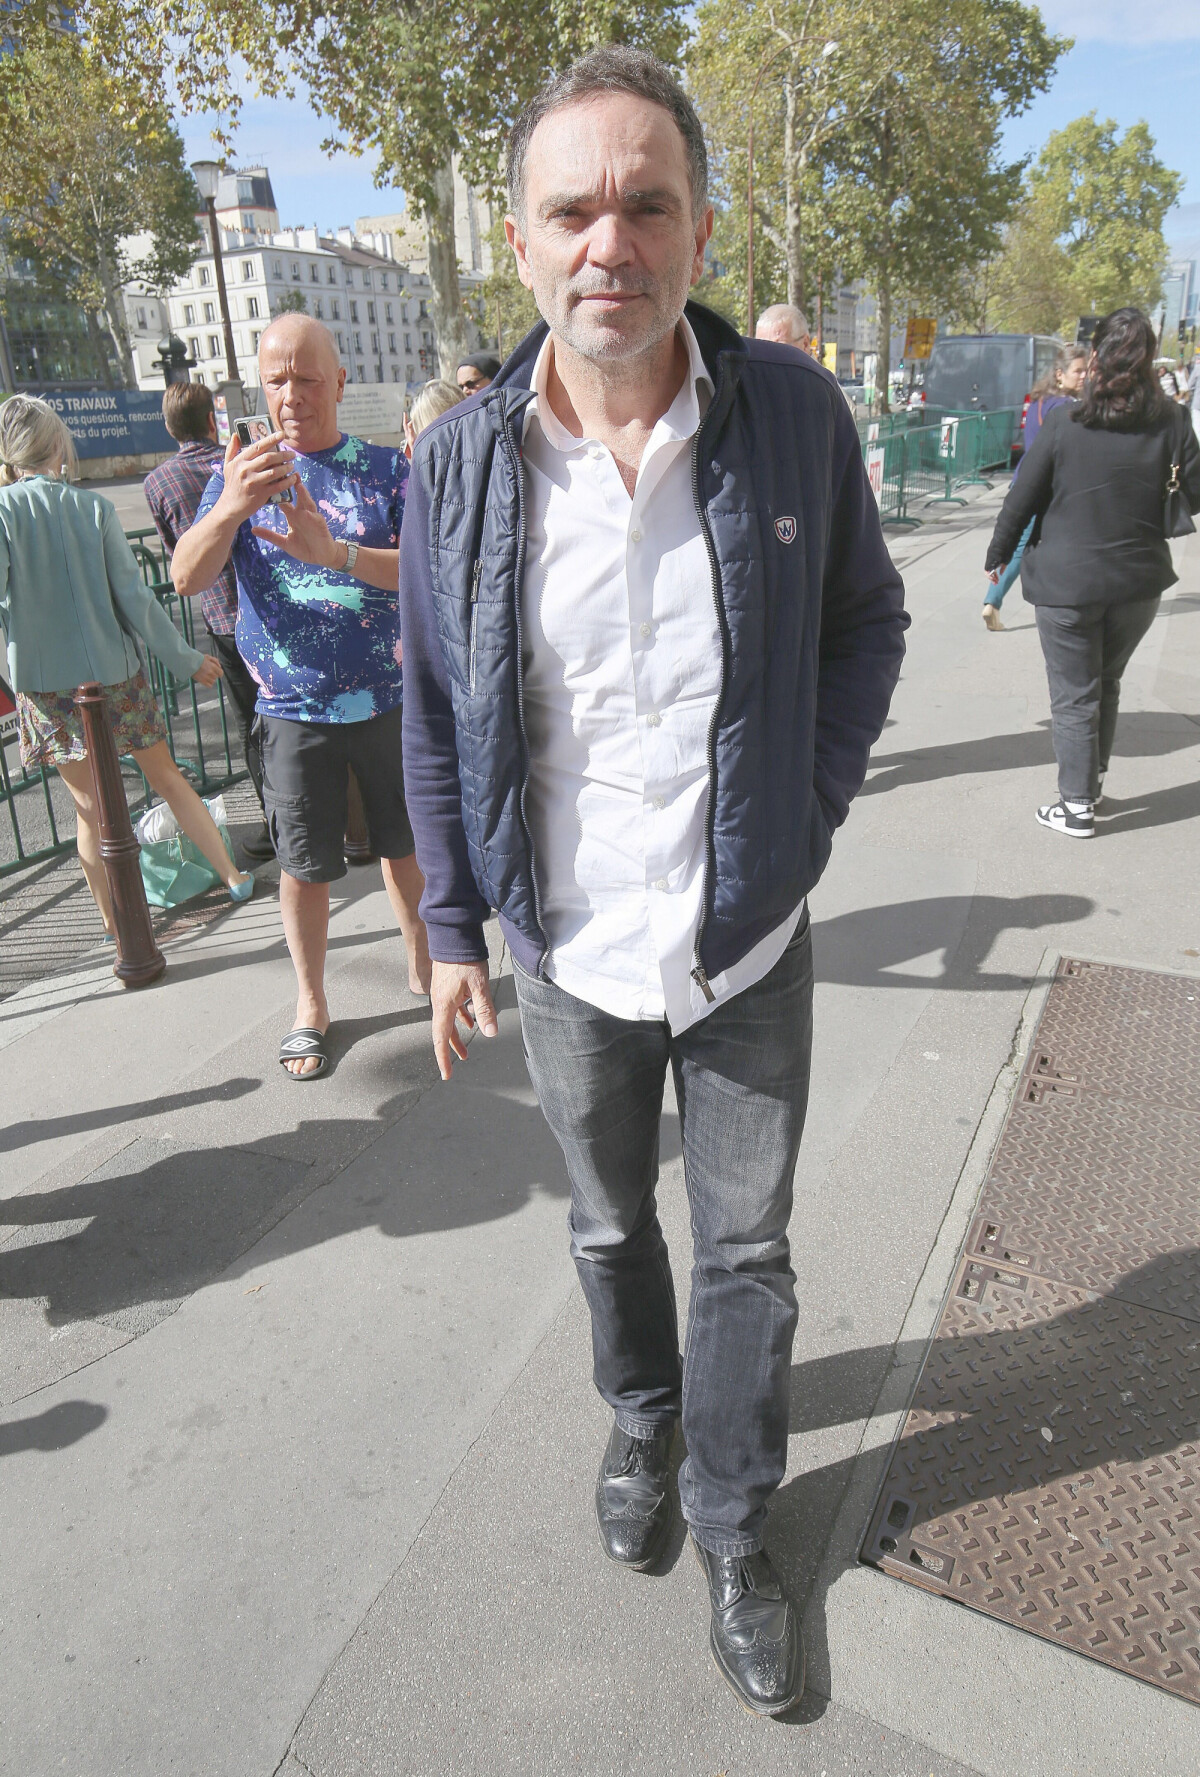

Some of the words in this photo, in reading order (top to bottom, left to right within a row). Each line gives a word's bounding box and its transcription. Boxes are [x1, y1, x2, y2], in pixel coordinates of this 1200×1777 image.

[45, 398, 64, 411] OS
[65, 396, 117, 411] TRAVAUX
[81, 412, 127, 426] questions,
[88, 426, 100, 438] du
[102, 425, 131, 439] projet.
